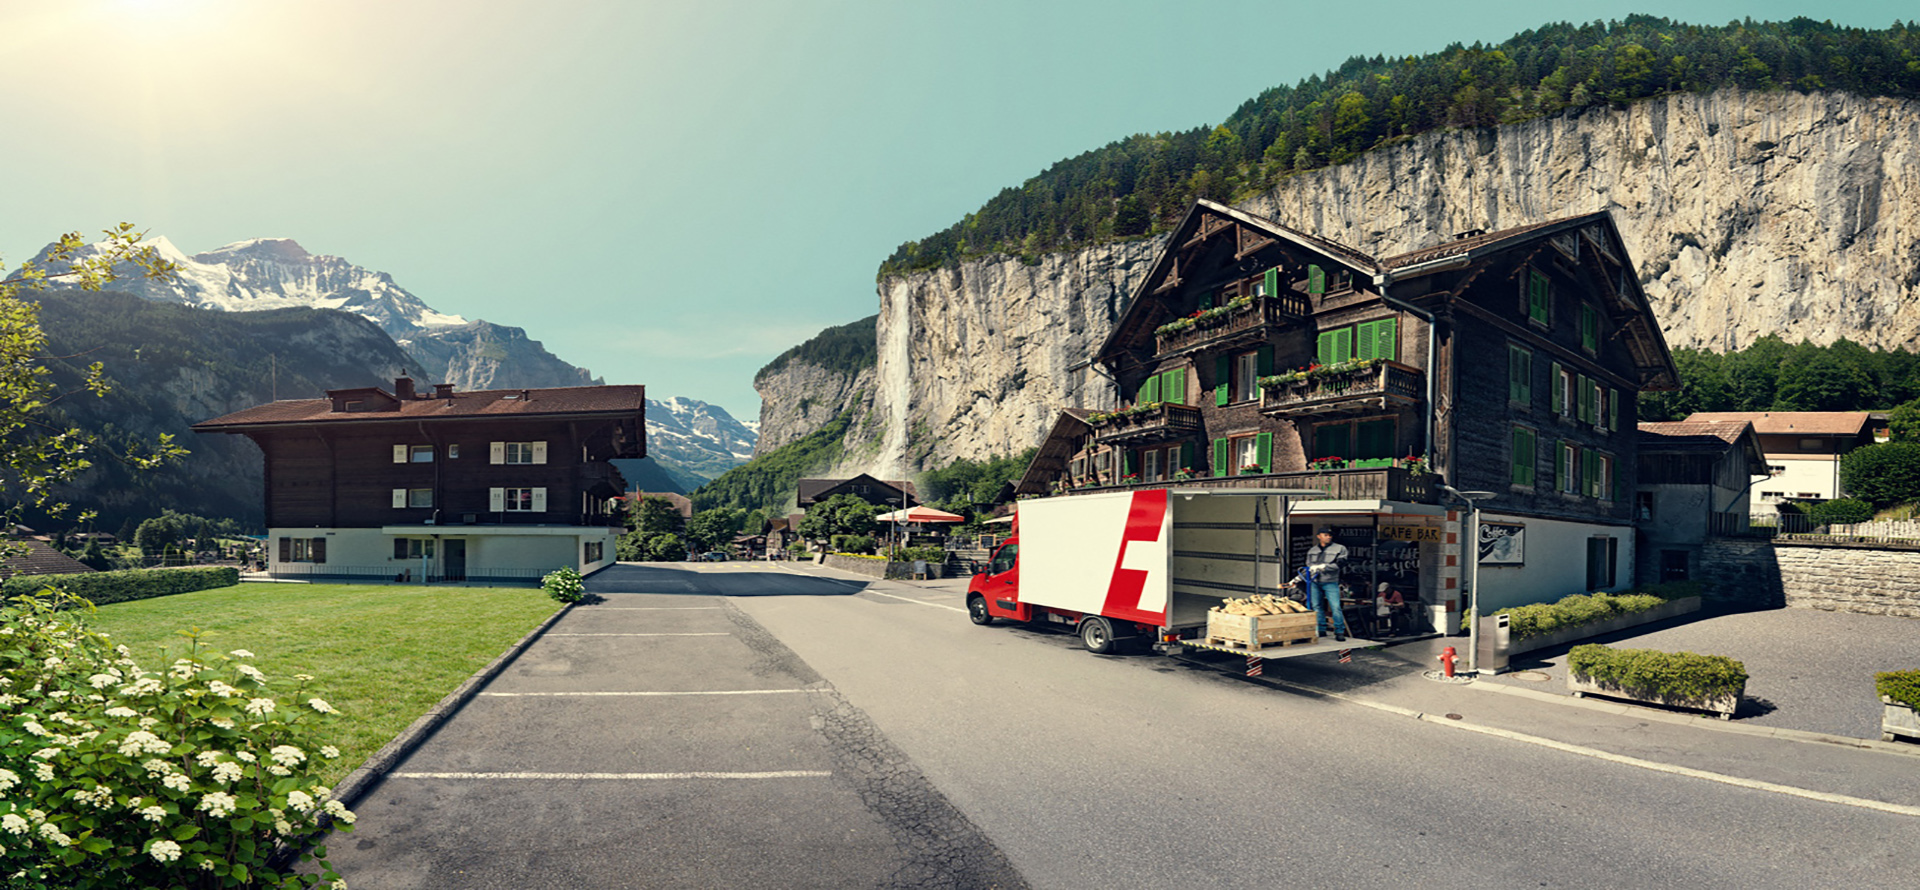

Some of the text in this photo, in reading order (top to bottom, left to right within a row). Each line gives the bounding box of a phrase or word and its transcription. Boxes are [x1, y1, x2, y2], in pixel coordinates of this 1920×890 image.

[1339, 528, 1375, 537] AIRTIM
[1417, 528, 1439, 540] BAR
[1479, 524, 1508, 541] Coffee
[1392, 559, 1420, 579] you
